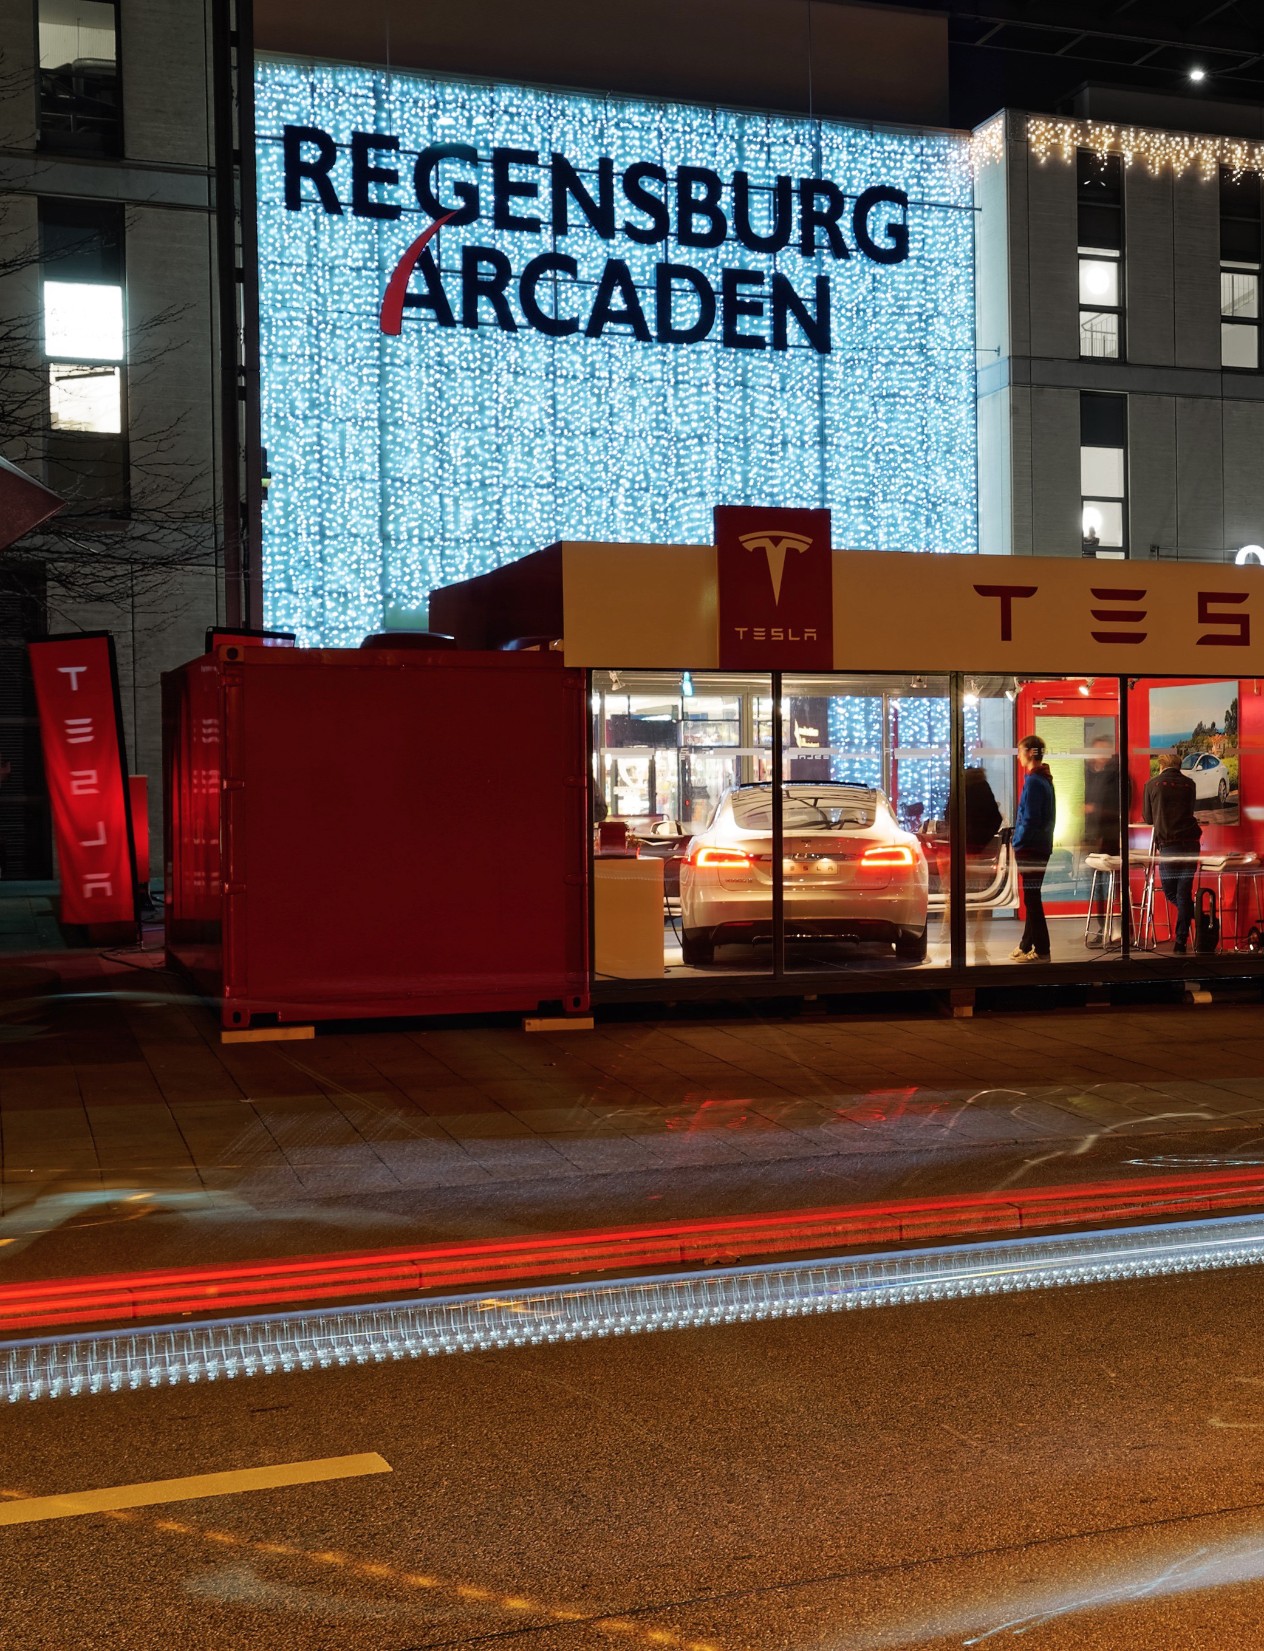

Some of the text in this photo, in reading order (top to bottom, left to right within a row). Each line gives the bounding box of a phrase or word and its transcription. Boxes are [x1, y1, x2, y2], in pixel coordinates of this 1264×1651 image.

[282, 123, 910, 265] REGENSBURG
[380, 210, 832, 355] ARCADEN
[735, 627, 817, 641] TESLA
